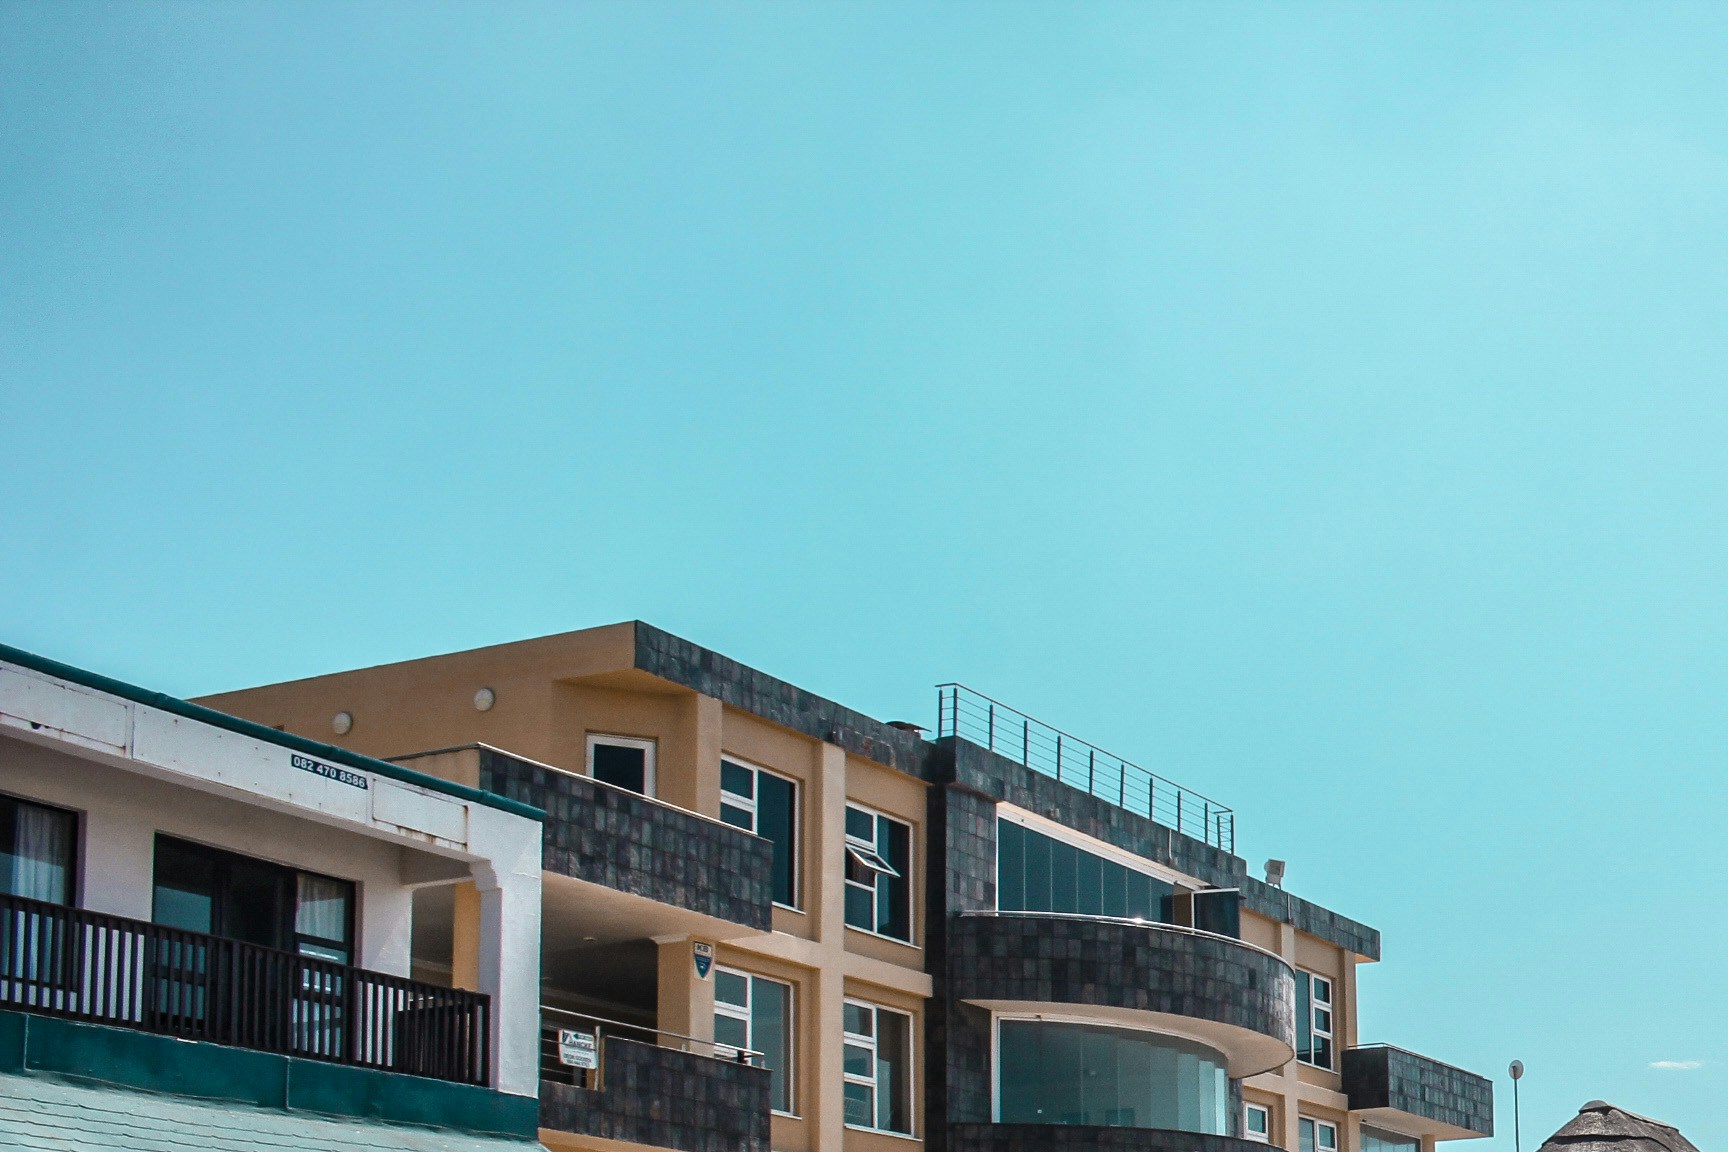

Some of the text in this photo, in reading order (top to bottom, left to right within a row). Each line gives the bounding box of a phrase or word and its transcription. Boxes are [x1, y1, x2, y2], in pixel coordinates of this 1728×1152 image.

[293, 756, 366, 788] 082 470 8586
